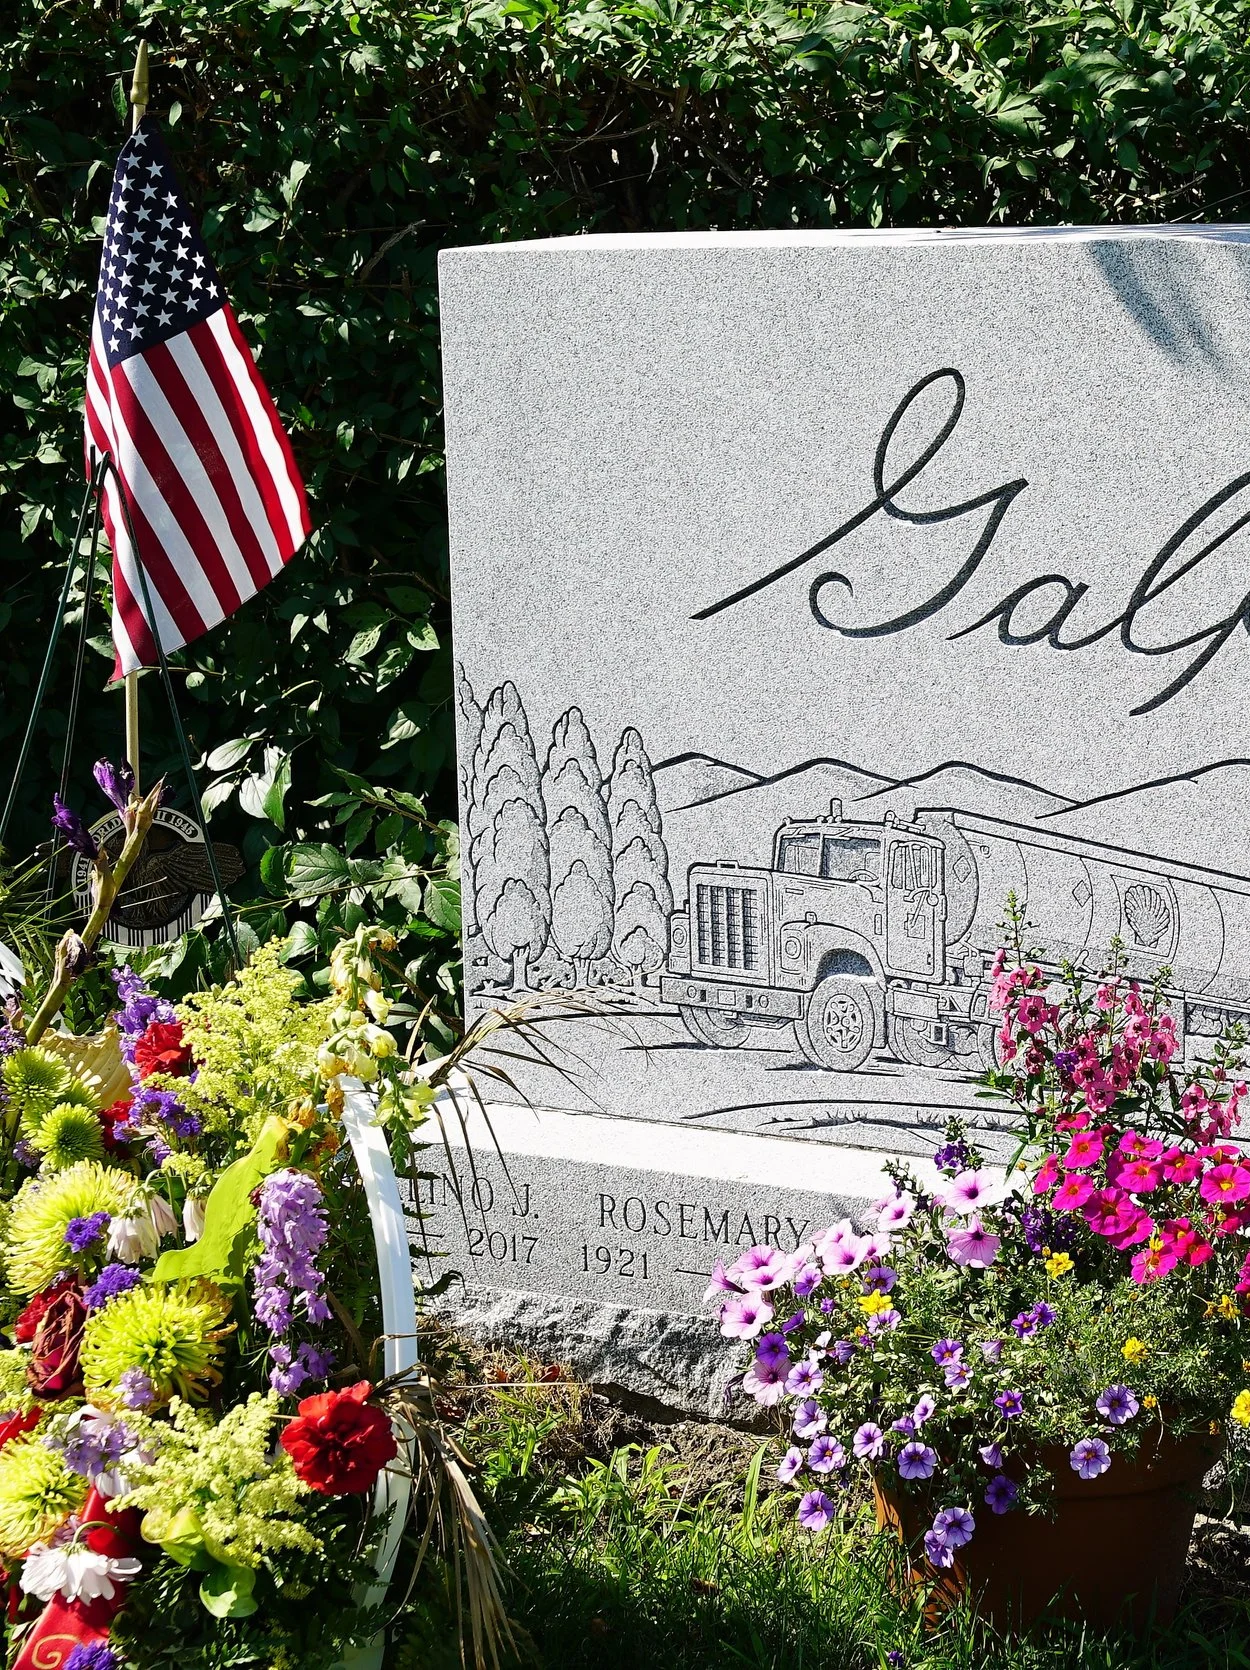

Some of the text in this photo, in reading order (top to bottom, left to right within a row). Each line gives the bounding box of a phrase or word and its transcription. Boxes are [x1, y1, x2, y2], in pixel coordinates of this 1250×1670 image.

[77, 857, 91, 884] 1941
[91, 817, 122, 844] ORLD
[170, 814, 194, 836] 1945
[400, 1173, 539, 1218] LINO J.
[599, 1193, 811, 1251] ROSEMARY
[469, 1228, 539, 1264] 2017
[582, 1244, 650, 1280] 1921
